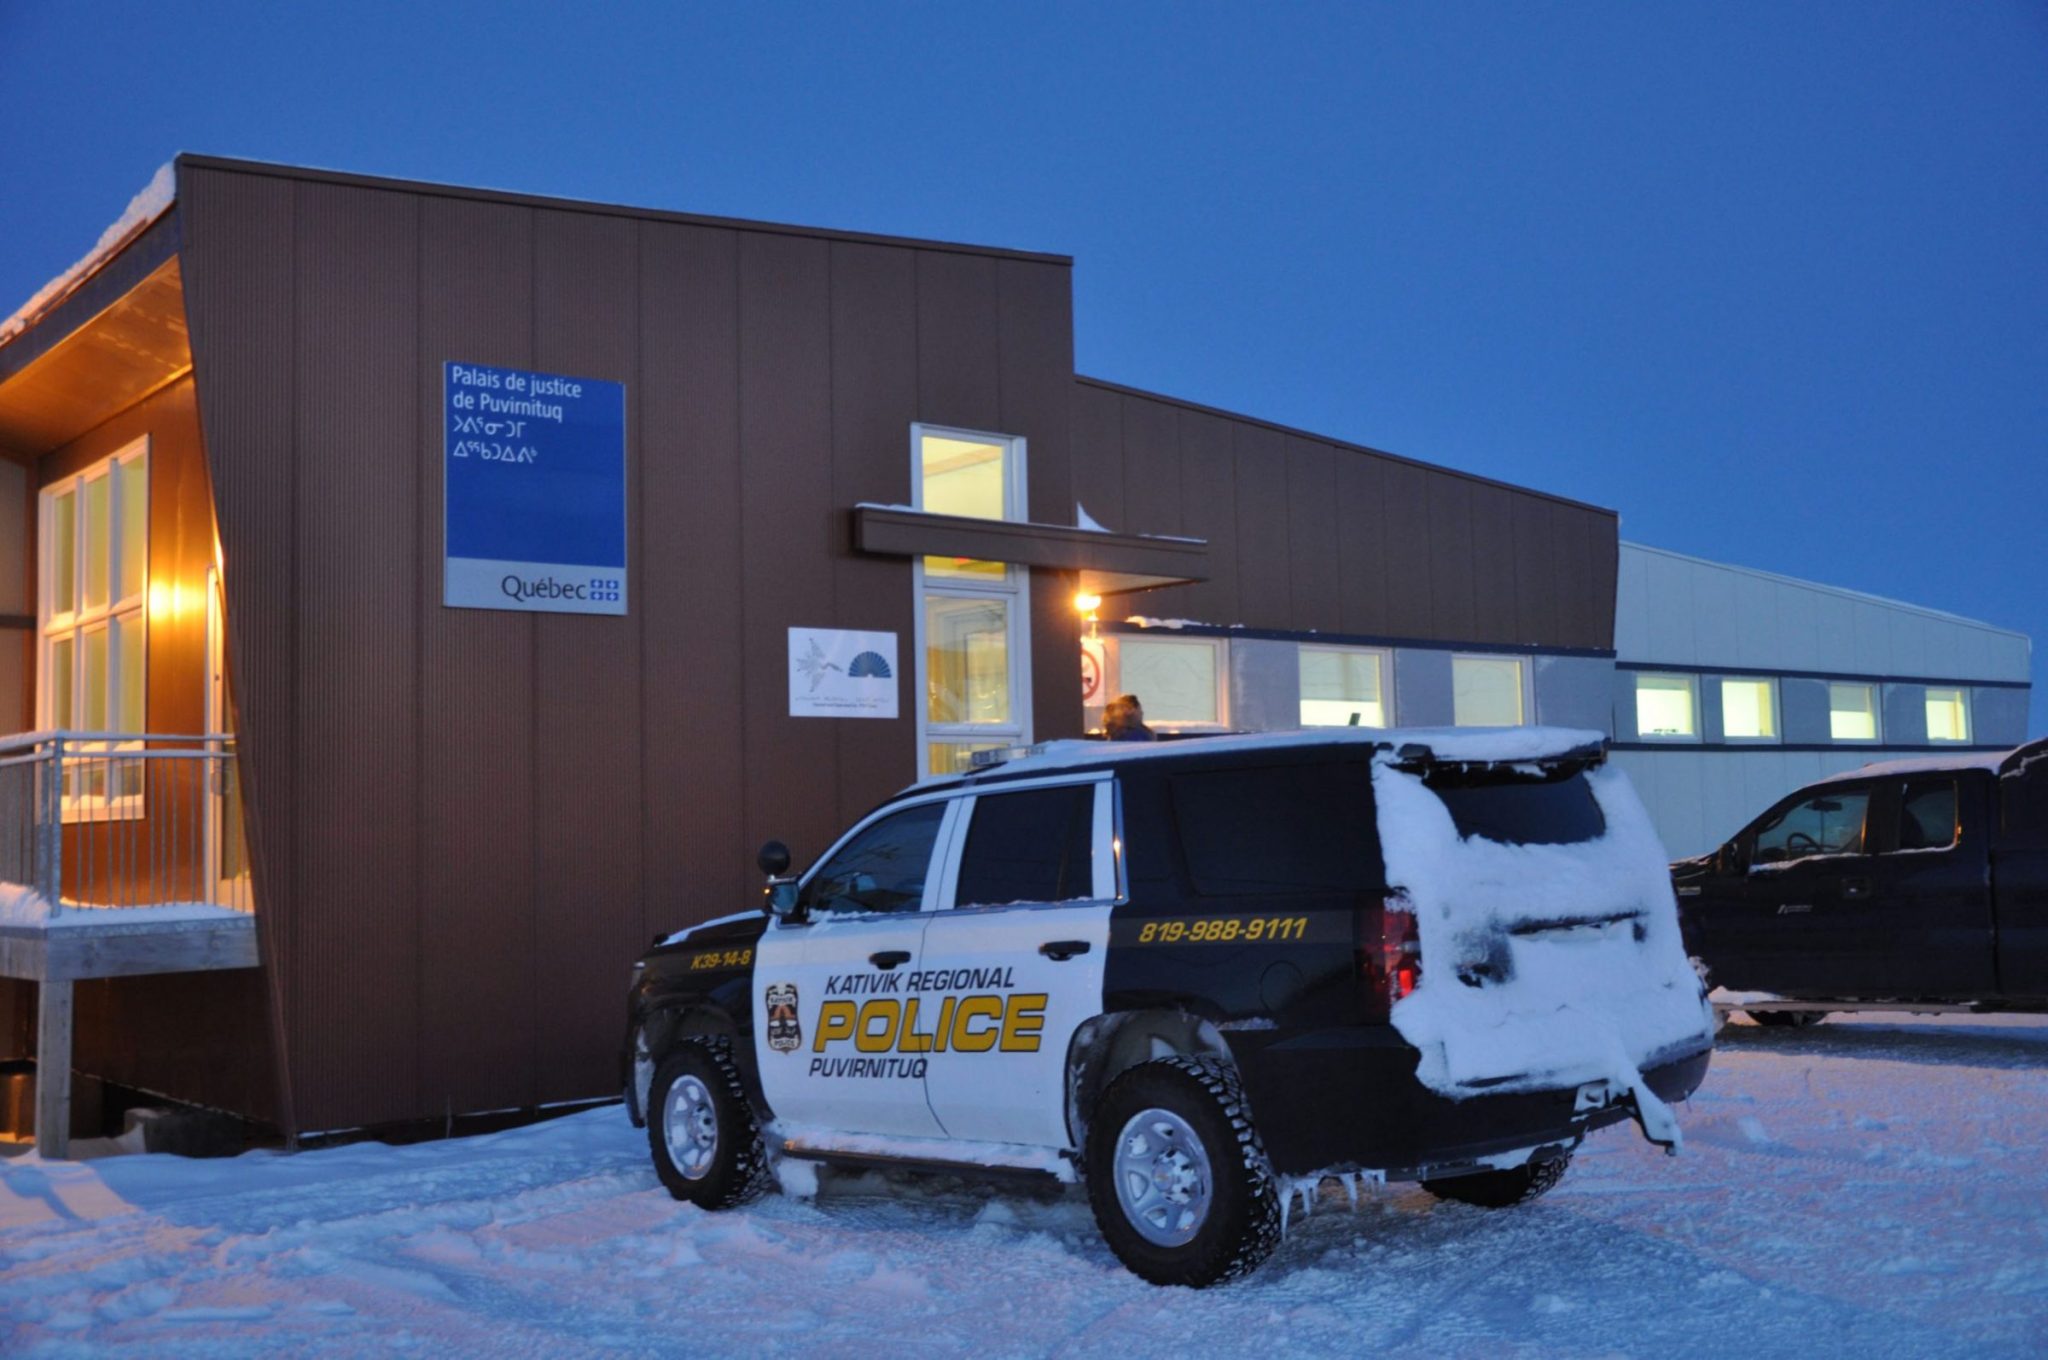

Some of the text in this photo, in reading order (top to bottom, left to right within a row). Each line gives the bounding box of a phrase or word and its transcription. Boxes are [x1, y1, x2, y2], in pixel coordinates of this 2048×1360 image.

[452, 366, 582, 398] Palais de justice
[453, 391, 563, 423] de Puvirnituq
[501, 575, 587, 602] Québec
[1138, 917, 1308, 943] 819-988-9111
[690, 949, 752, 970] K39-14-8
[825, 967, 1015, 995] KATIVIK REGIONAL
[812, 993, 1049, 1053] POLICE
[809, 1058, 929, 1079] PUVIRNITUQ
